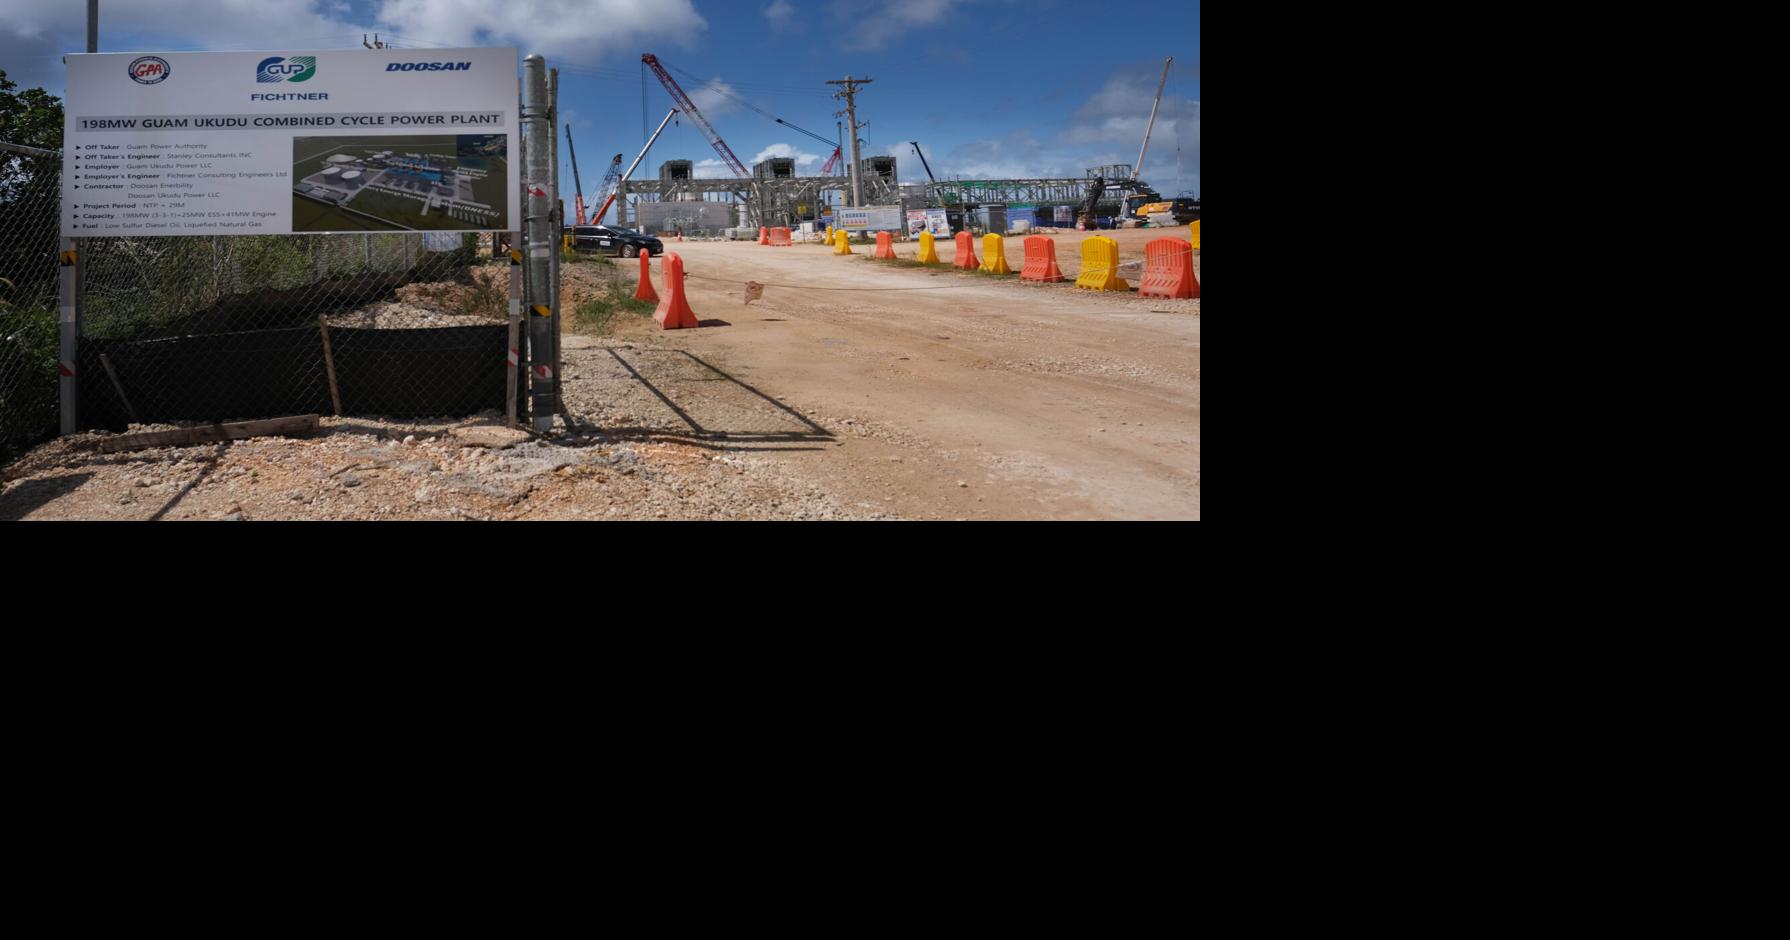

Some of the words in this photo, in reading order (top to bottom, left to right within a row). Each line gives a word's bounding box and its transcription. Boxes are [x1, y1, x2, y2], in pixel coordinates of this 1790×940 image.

[135, 64, 162, 77] GPA
[267, 64, 304, 74] GUP
[385, 62, 472, 71] DOOSAN
[82, 119, 136, 129] 198MW
[142, 118, 188, 128] GUAM
[194, 118, 247, 127] UKUDU
[253, 116, 335, 126] COMBINED
[341, 116, 384, 125] CYCLE
[390, 115, 445, 124] POWER
[451, 114, 500, 124] PLANT
